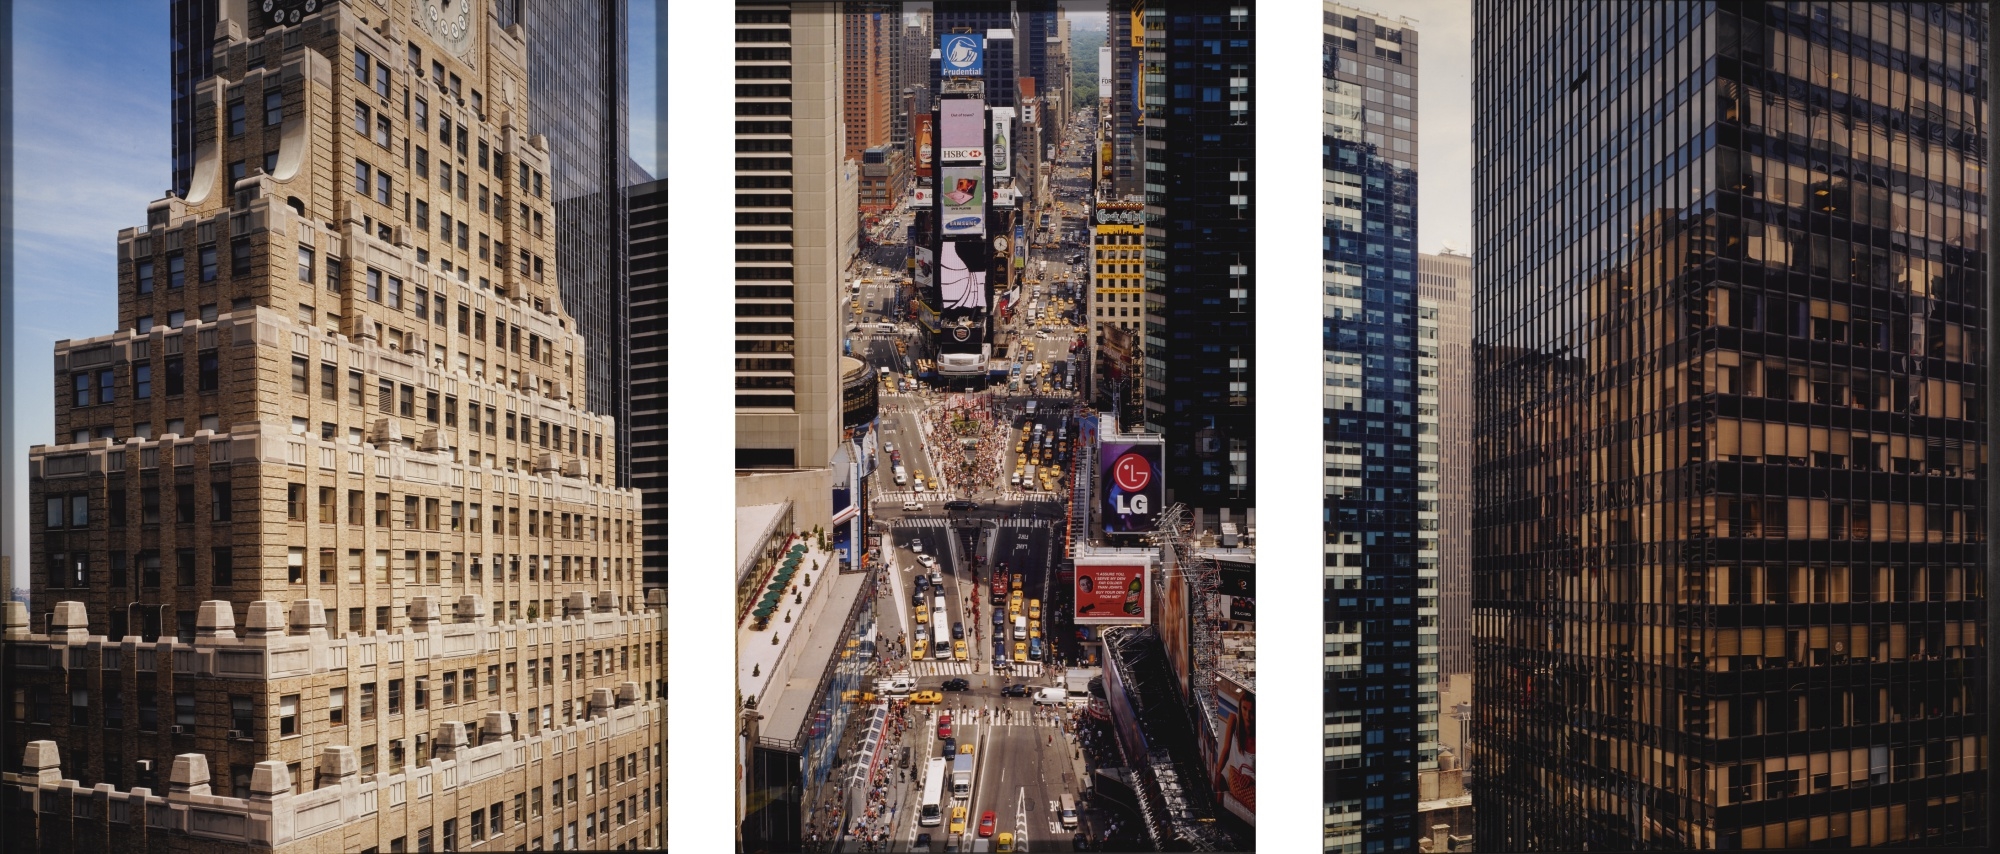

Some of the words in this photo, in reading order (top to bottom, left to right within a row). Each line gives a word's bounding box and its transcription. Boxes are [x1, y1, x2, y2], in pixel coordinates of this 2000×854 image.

[943, 68, 982, 76] Prudential
[943, 150, 968, 159] HSBC
[1116, 494, 1148, 514] LG
